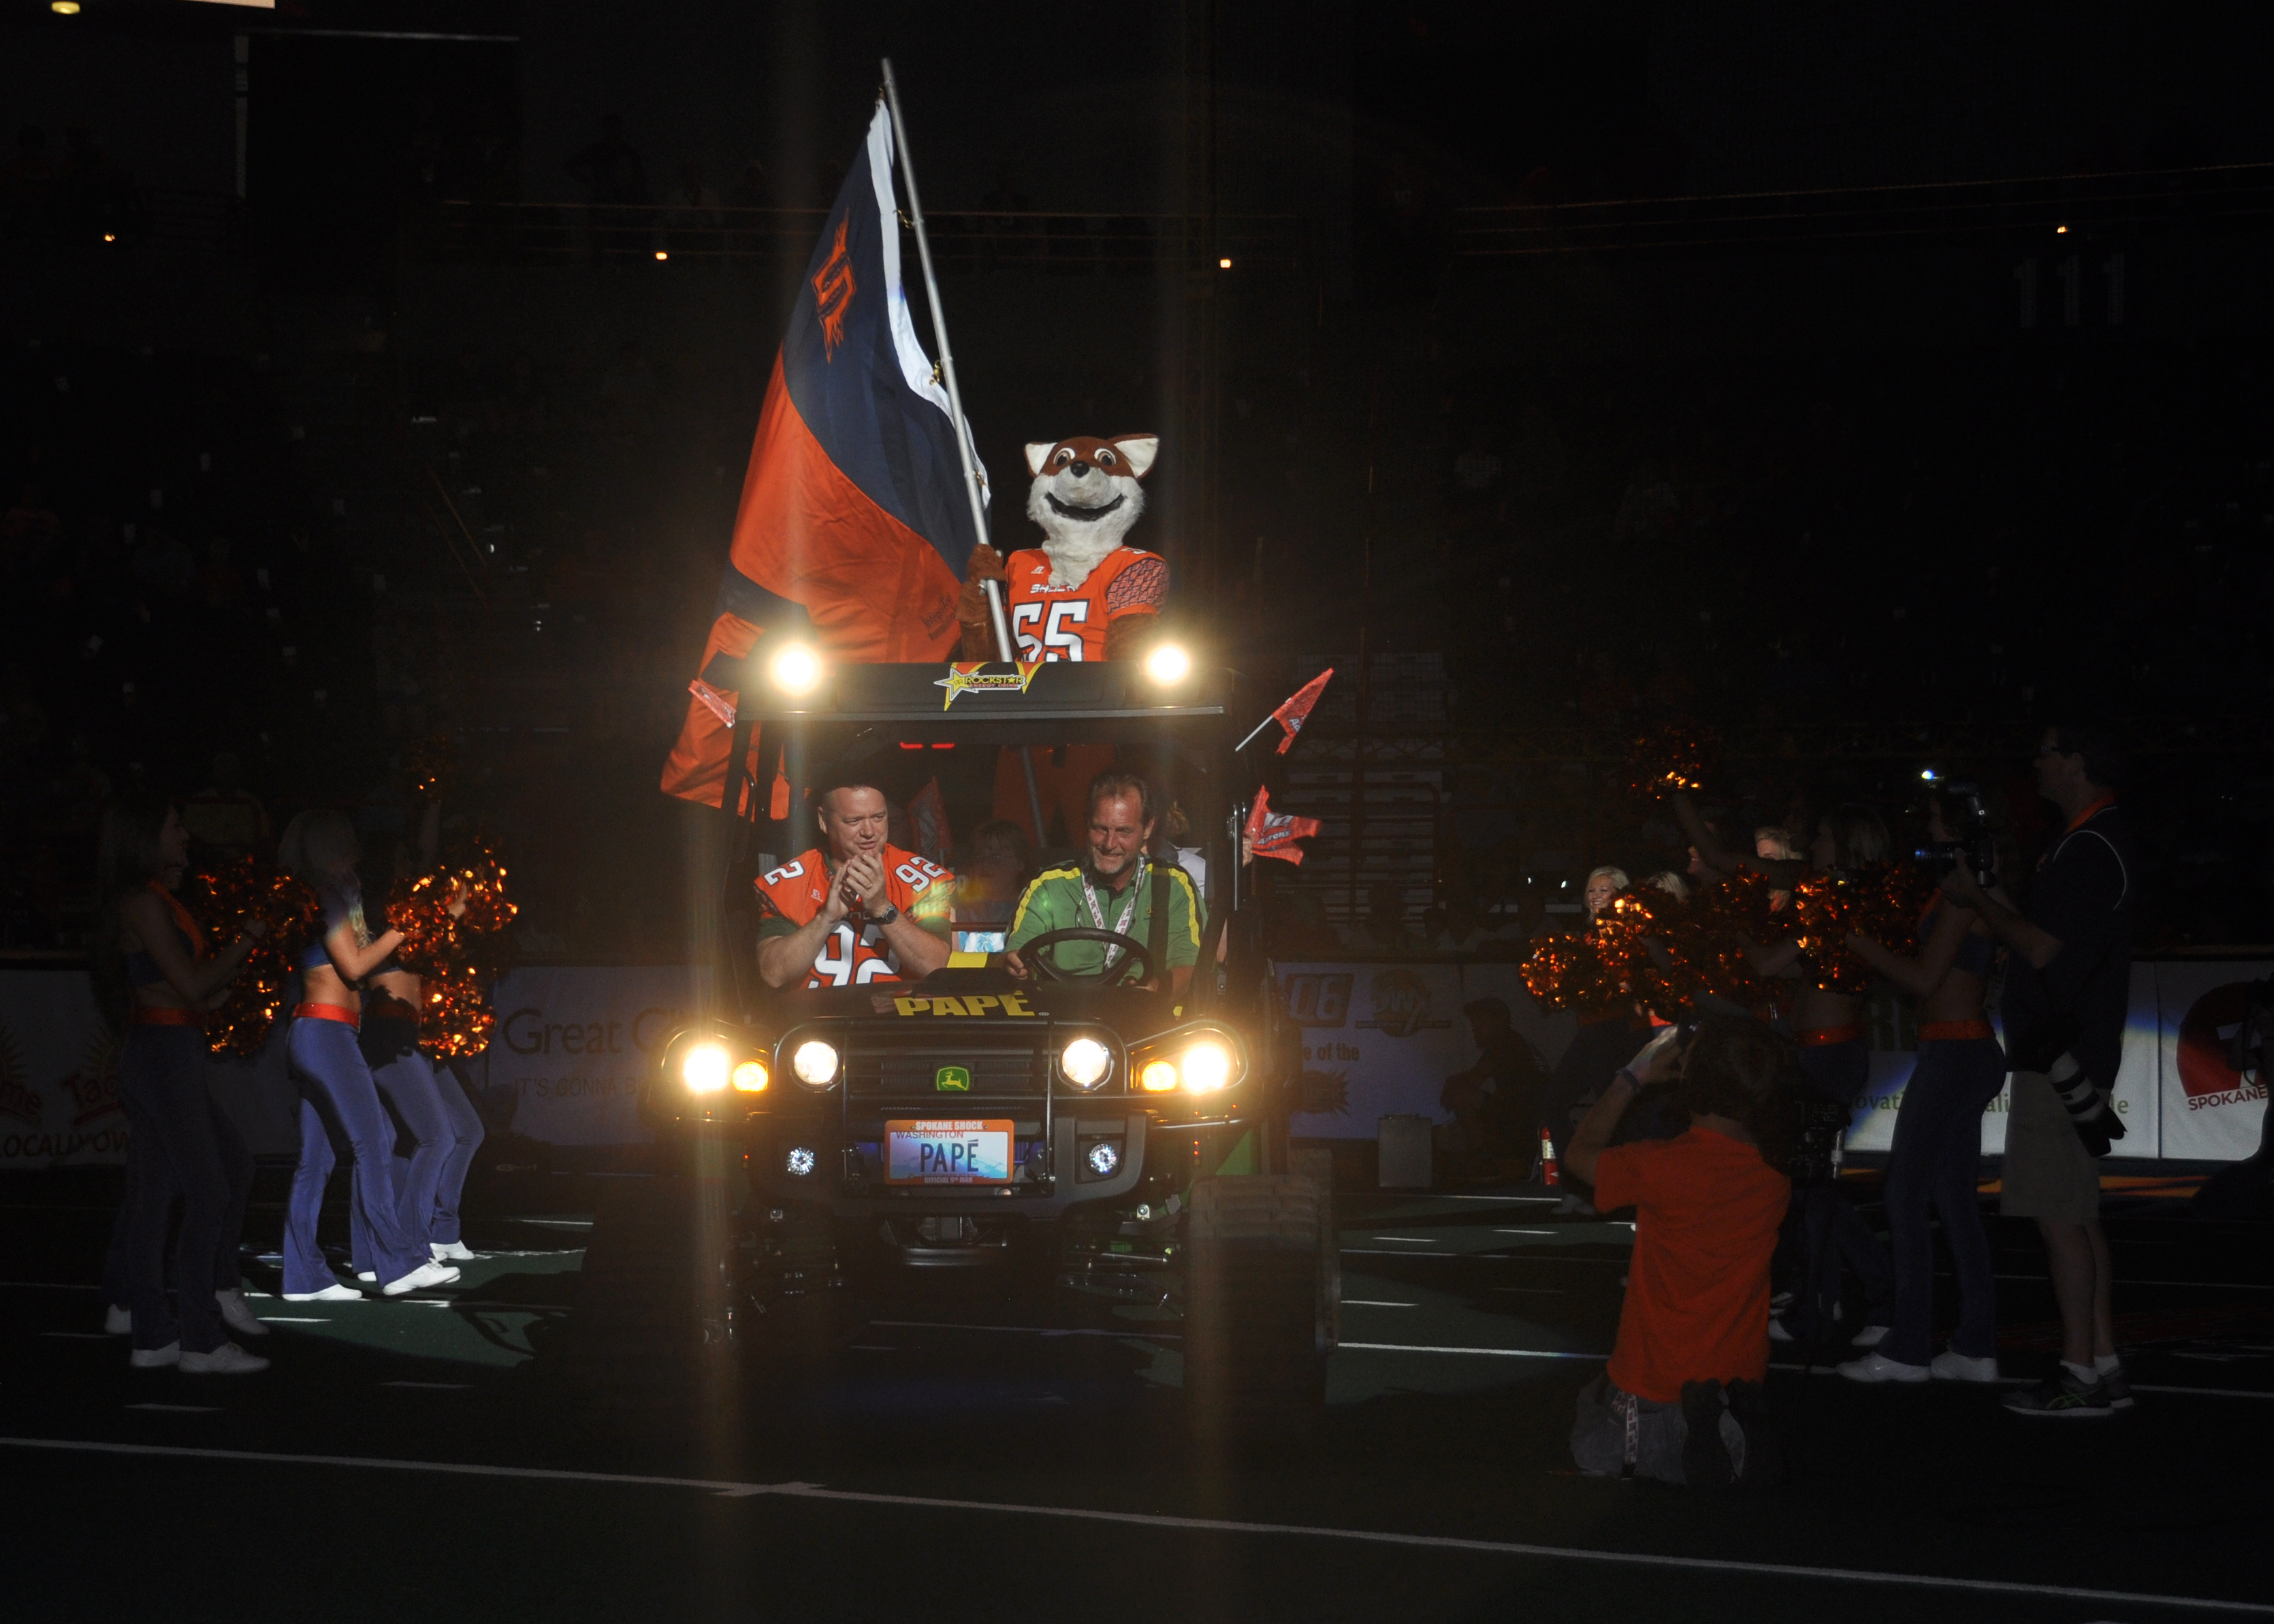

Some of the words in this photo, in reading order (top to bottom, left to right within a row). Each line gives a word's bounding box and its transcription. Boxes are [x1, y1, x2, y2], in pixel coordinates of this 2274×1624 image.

[2013, 253, 2125, 329] 111
[1012, 598, 1090, 662] 55
[895, 856, 948, 893] 92
[808, 920, 900, 987] 92
[502, 1008, 622, 1054] Great
[1317, 1043, 1332, 1061] of
[1336, 1043, 1360, 1061] the
[556, 1077, 618, 1096] GONNA
[2188, 1087, 2269, 1111] SPOKANE
[895, 1131, 964, 1139] WASHINGTON
[915, 1121, 953, 1131] SPOKANE
[954, 1120, 984, 1130] SHOCK
[0, 1133, 91, 1158] OCALLY
